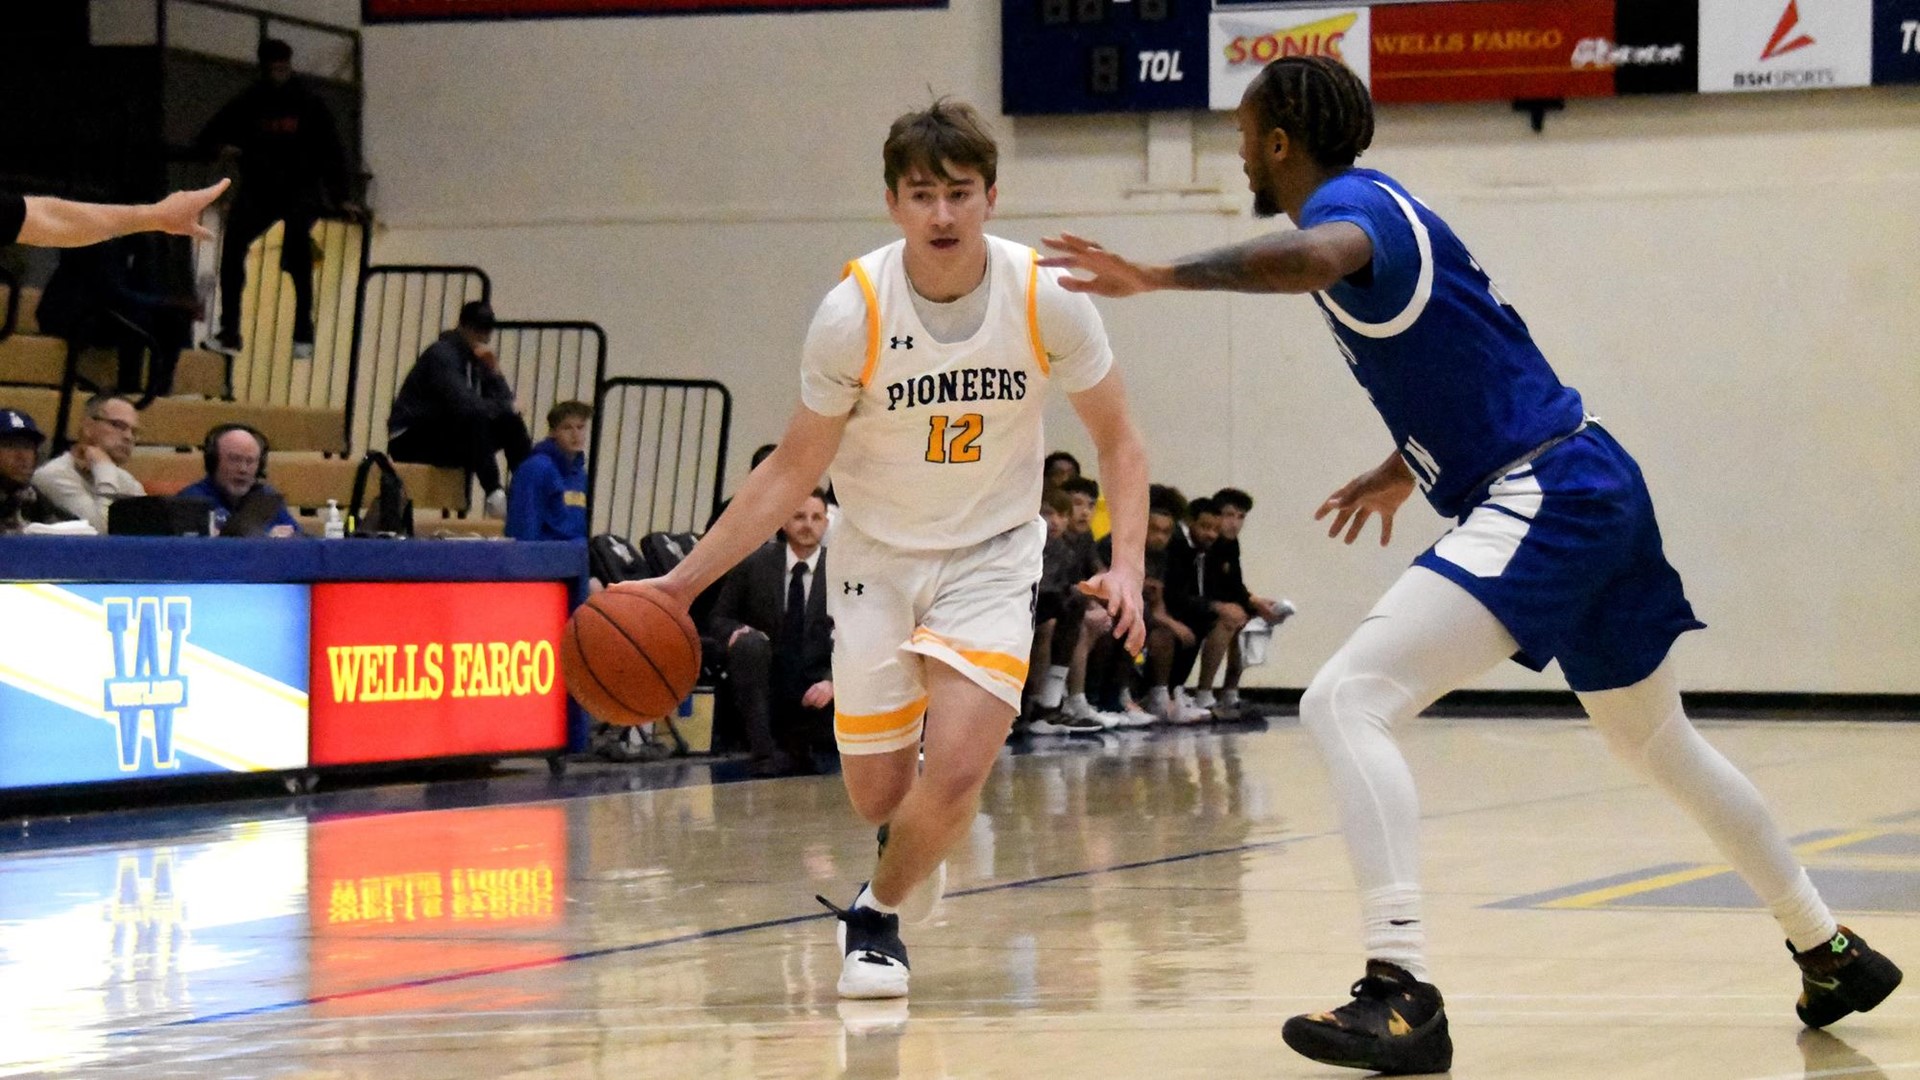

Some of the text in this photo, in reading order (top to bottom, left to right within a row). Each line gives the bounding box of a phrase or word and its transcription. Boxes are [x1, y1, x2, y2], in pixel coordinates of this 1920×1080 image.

[1138, 50, 1184, 82] TOL
[1228, 31, 1345, 65] SONIC
[887, 367, 1027, 410] PIONEERS
[925, 413, 984, 464] 12
[327, 640, 555, 703] WELLS FARGO
